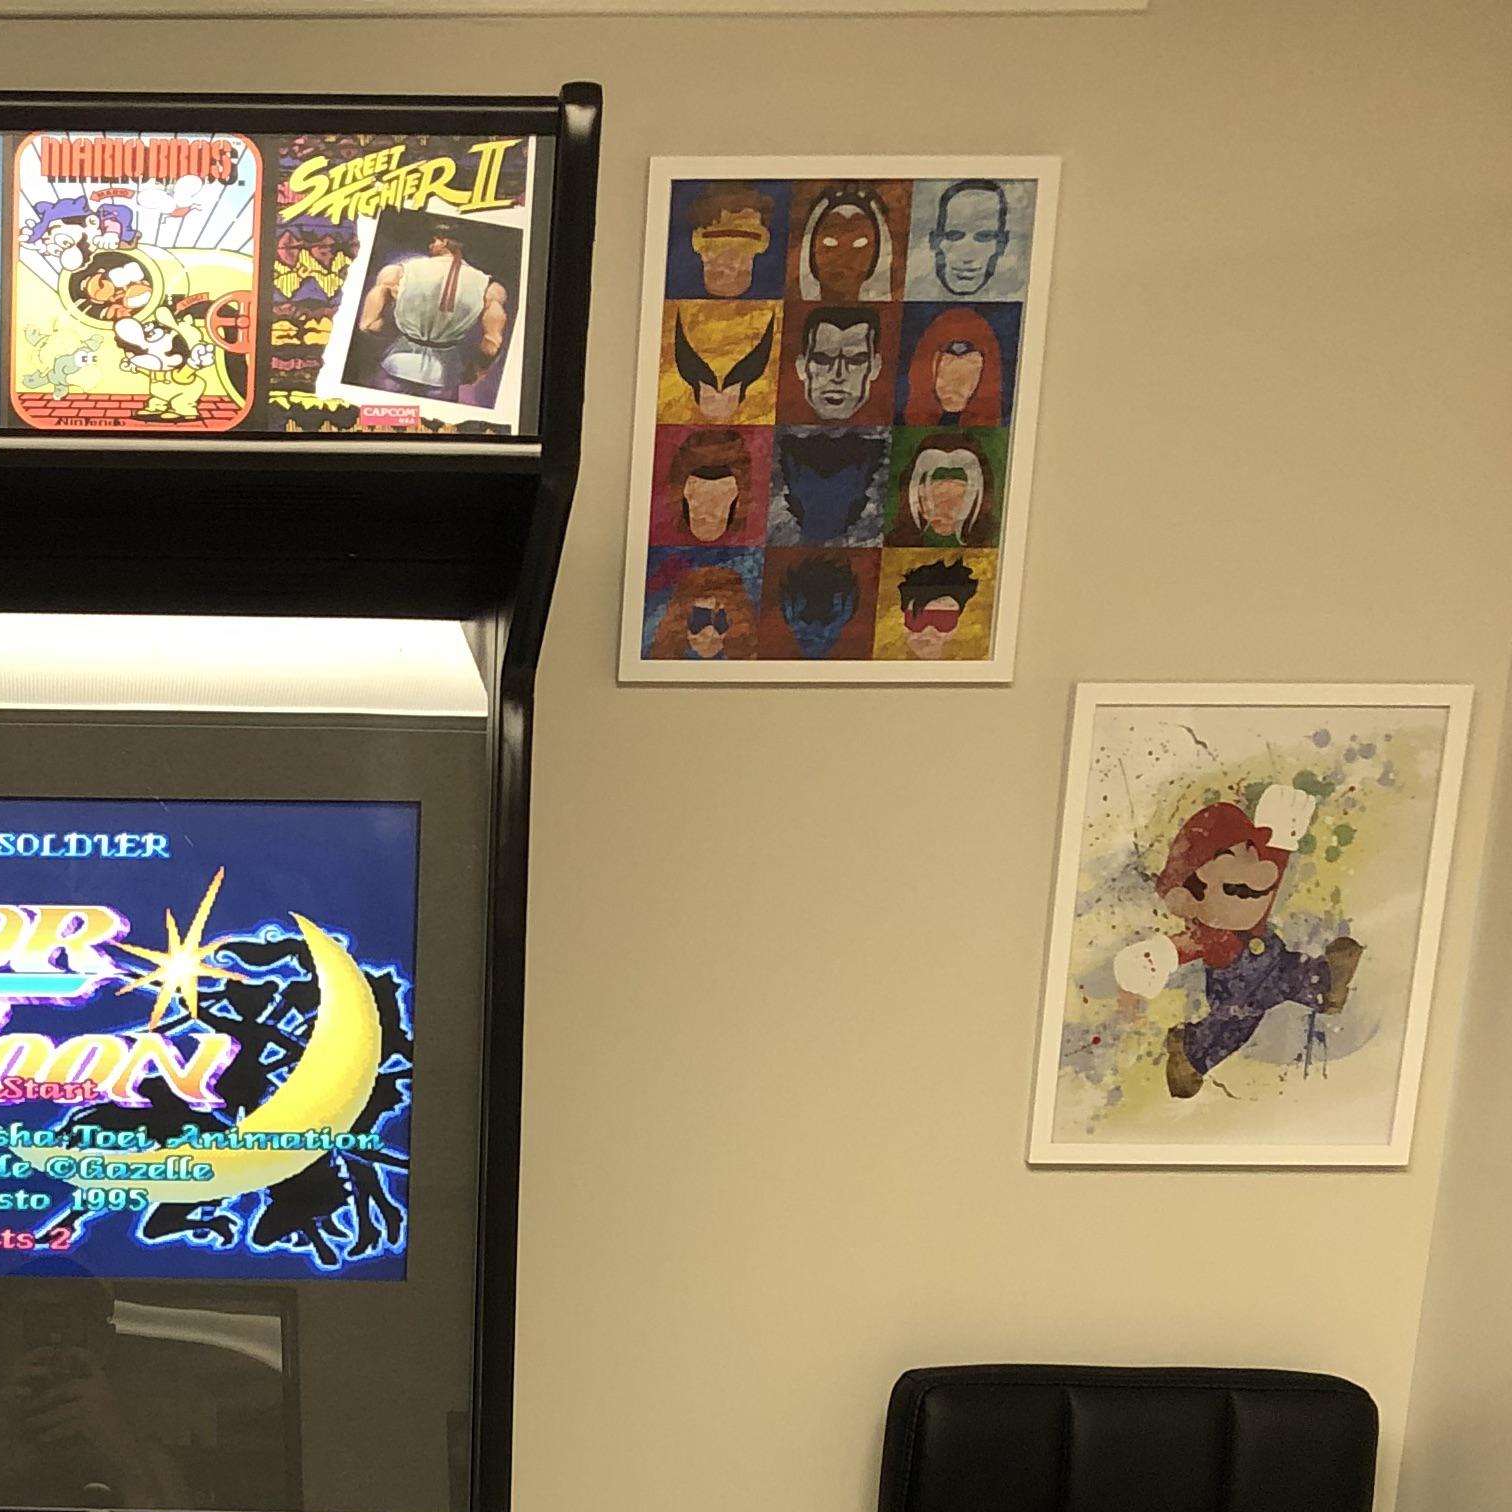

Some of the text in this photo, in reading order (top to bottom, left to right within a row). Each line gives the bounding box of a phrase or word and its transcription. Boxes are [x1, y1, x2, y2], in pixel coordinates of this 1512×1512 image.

[279, 138, 524, 225] STREET FIGHTER II
[363, 407, 418, 417] CAPCOM
[0, 1076, 100, 1102] Start
[167, 1124, 386, 1152] Animation
[71, 1188, 149, 1212] 1995
[48, 1227, 72, 1251] 2
